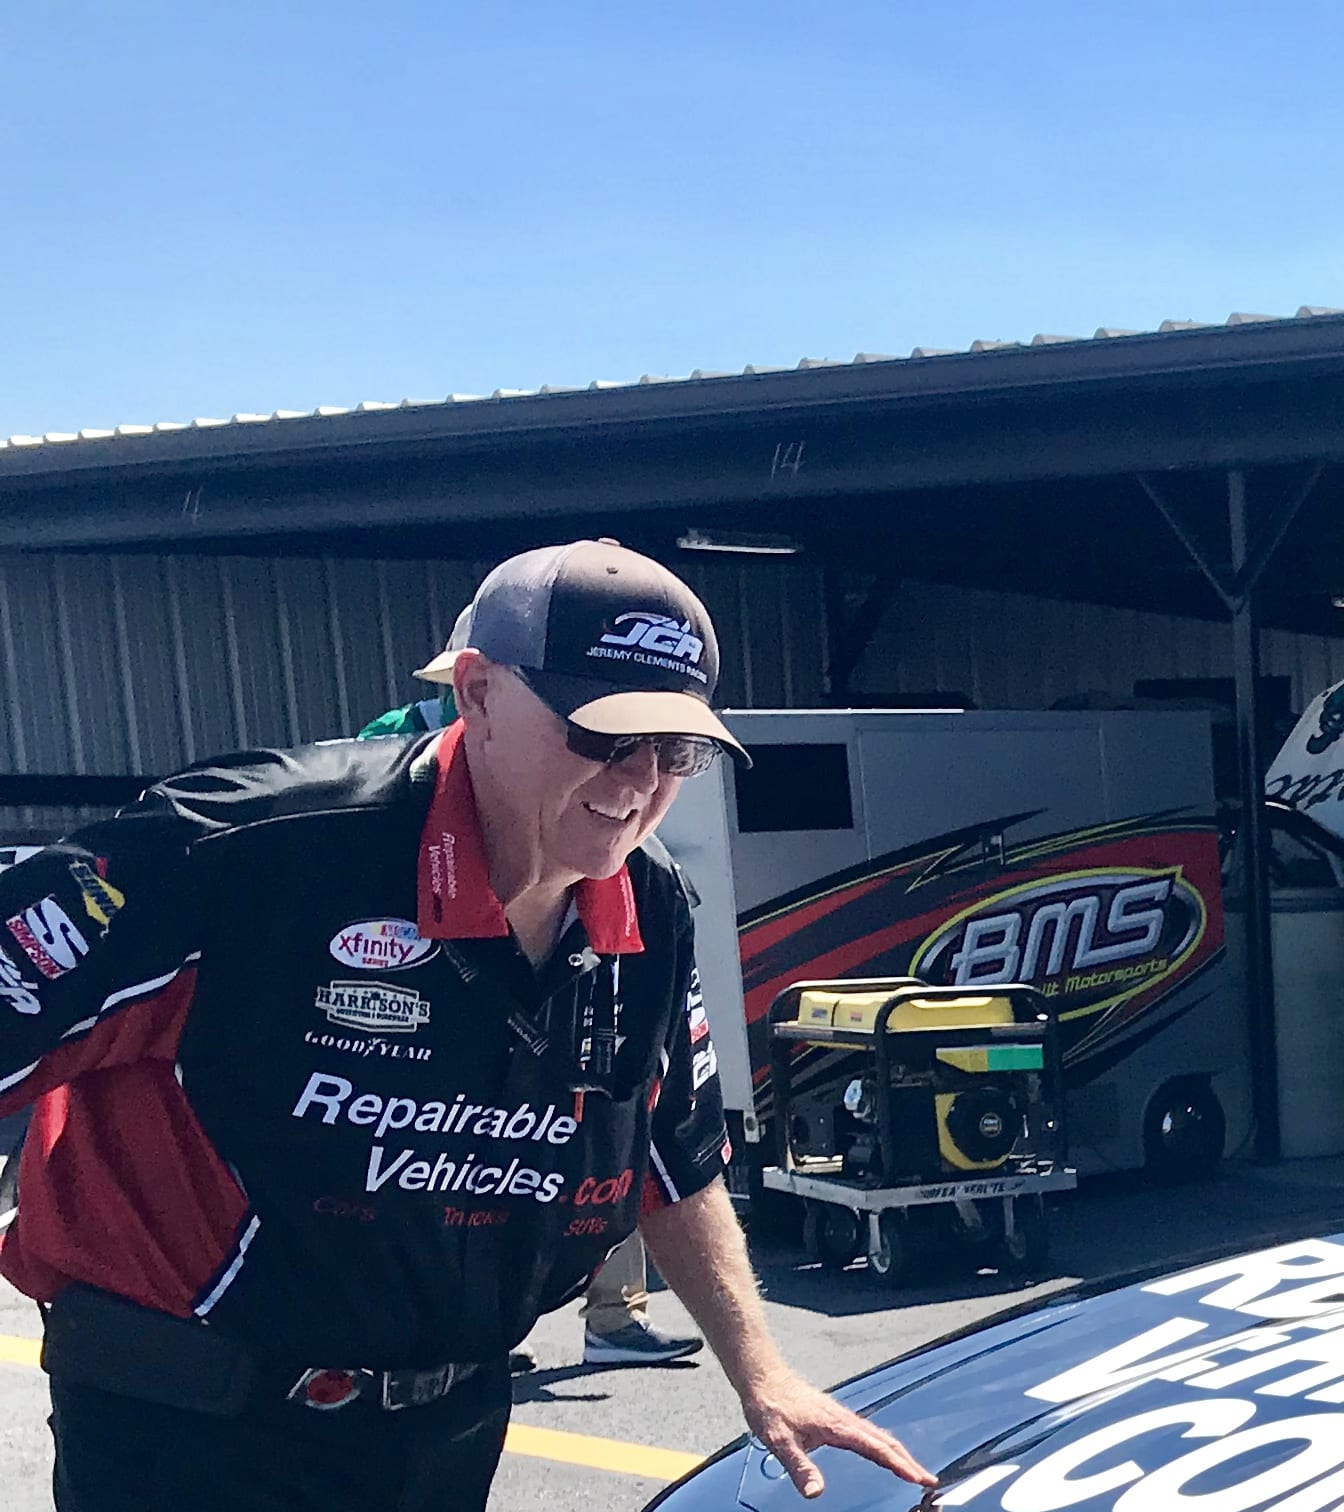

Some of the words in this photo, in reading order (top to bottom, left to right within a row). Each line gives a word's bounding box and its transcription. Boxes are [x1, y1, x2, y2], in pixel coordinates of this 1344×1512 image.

[586, 646, 632, 661] JEREMY
[633, 651, 686, 674] CLEMENTS
[338, 931, 415, 964] xfinity
[949, 879, 1174, 986] BMS
[303, 1030, 433, 1062] GOODYEAR
[291, 1071, 579, 1145] Repairable
